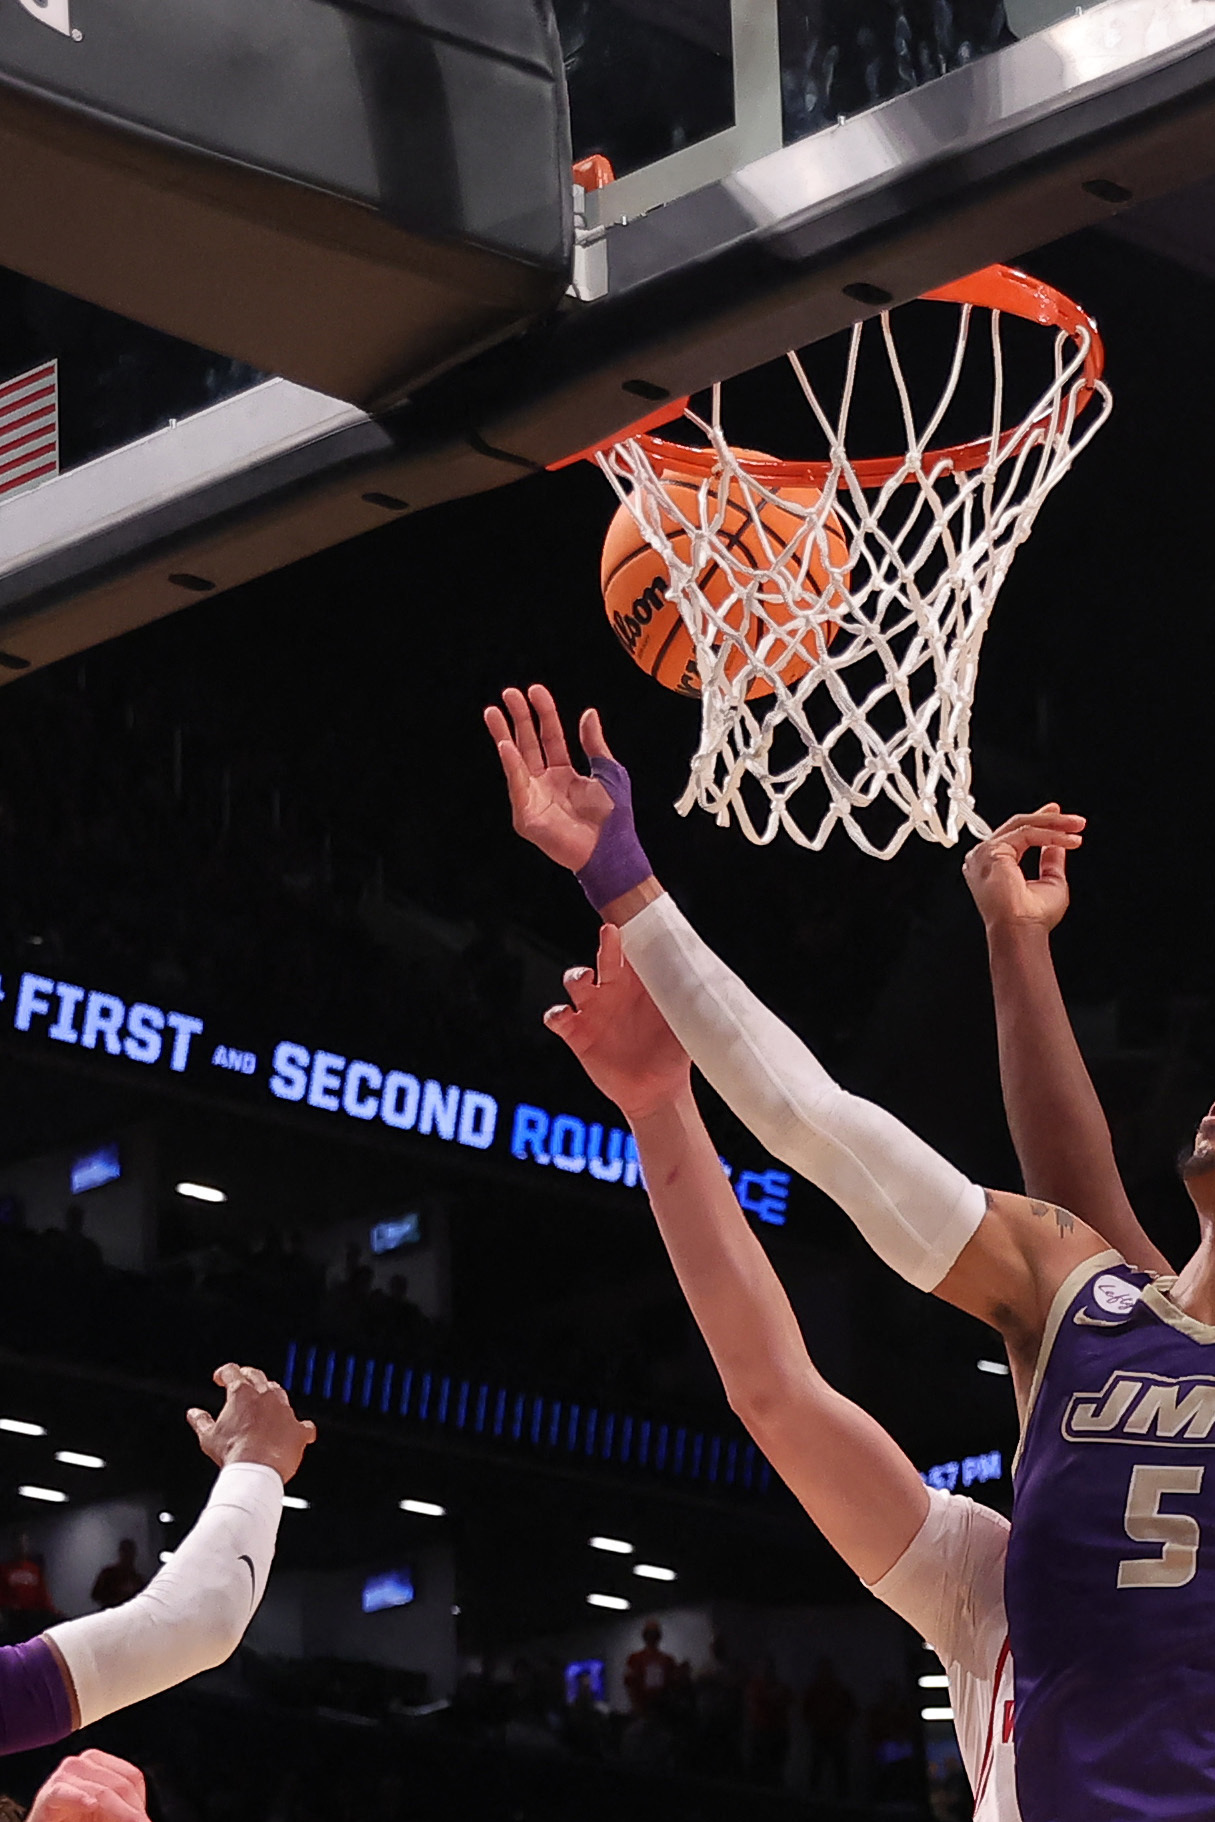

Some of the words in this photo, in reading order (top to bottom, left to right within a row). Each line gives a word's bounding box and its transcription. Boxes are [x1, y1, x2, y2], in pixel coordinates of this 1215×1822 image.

[14, 971, 204, 1073] FIRST
[211, 1044, 257, 1075] AND
[268, 1040, 498, 1150] SECOND
[1116, 1464, 1205, 1589] 5
